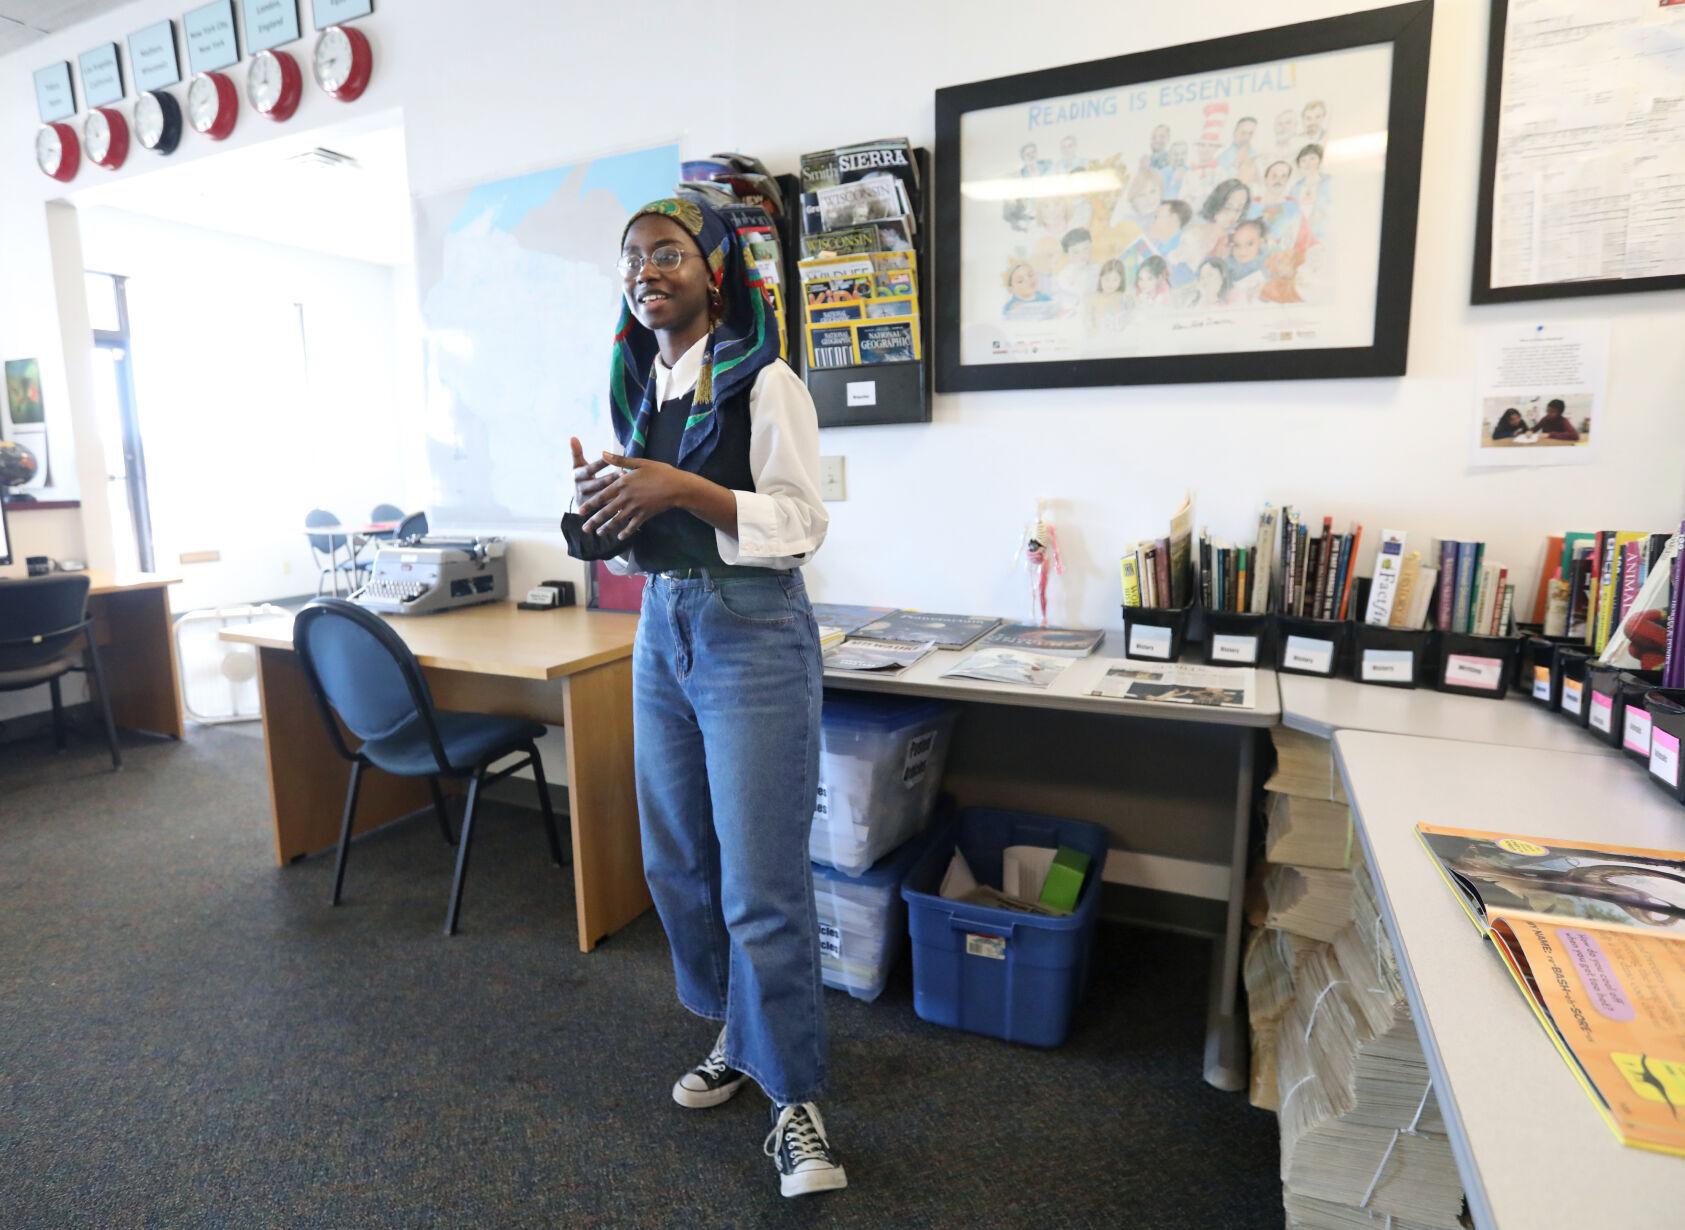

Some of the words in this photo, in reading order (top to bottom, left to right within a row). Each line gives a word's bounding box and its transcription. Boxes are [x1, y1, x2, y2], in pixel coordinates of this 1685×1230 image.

[1027, 95, 1119, 131] READING
[1129, 90, 1147, 112] IS
[1158, 63, 1297, 107] ESSENTIAL!
[838, 148, 908, 172] SIERRA
[825, 185, 890, 206] WISCONSIN
[807, 234, 872, 251] WISCONSIN
[861, 337, 910, 350] GEOGRAPHIC
[868, 330, 902, 339] NATIONAL
[1535, 930, 1551, 953] NAME:
[1566, 932, 1579, 950] when
